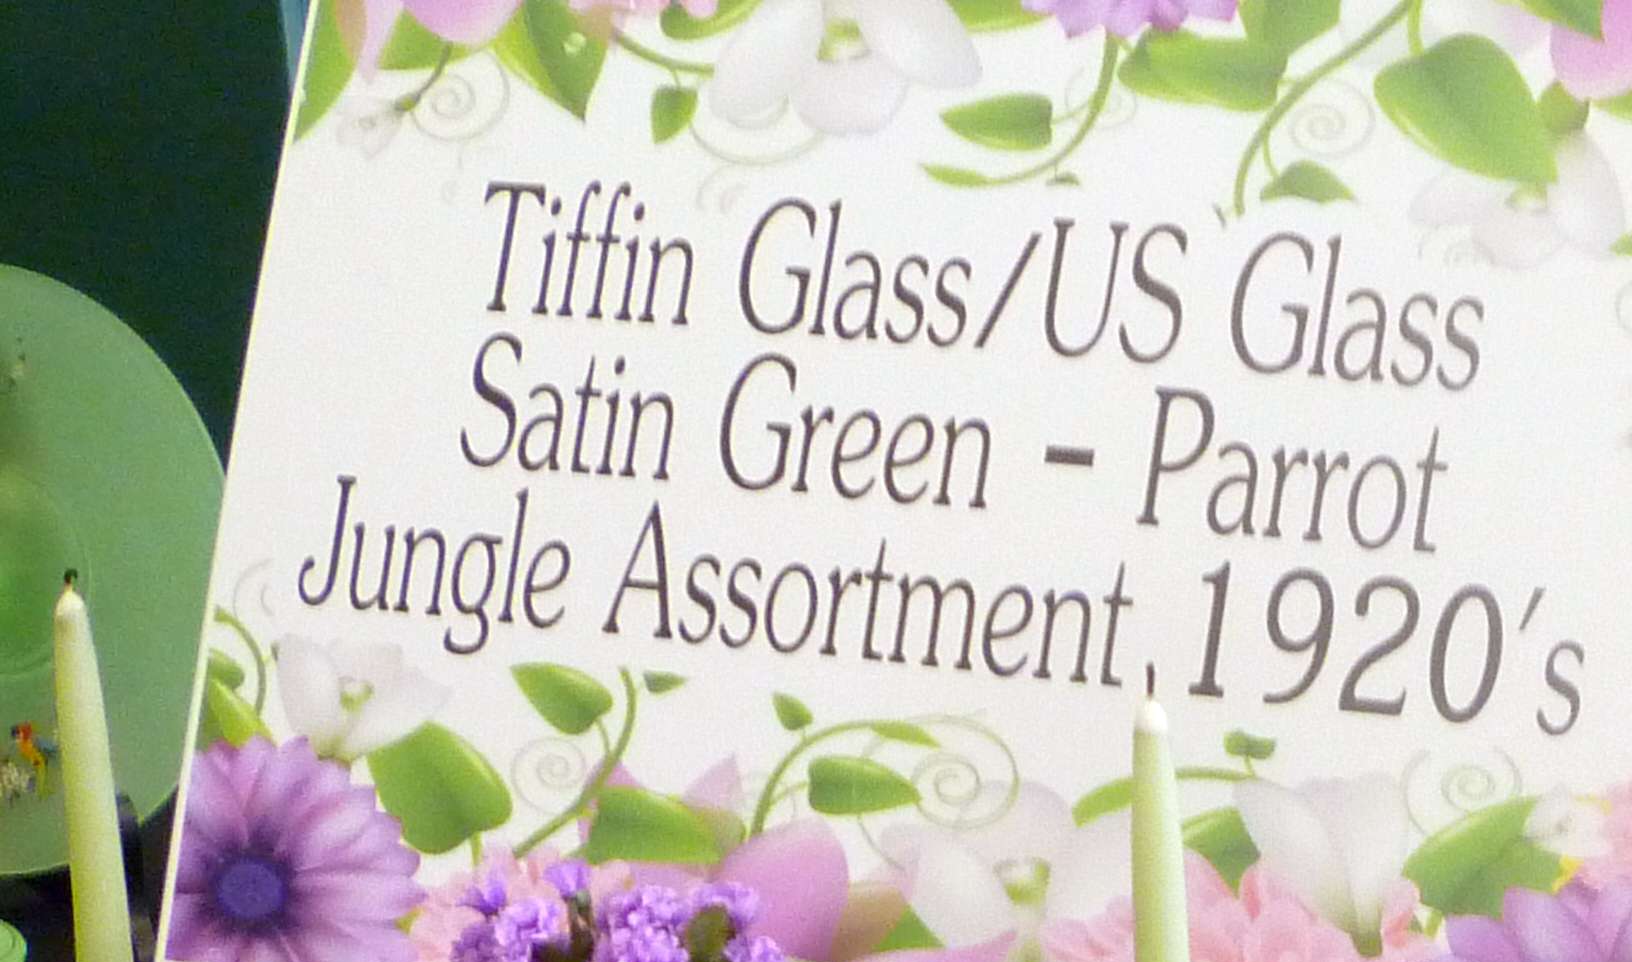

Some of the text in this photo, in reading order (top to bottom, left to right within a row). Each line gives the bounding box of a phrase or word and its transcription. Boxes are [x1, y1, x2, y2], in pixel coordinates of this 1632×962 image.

[484, 181, 1485, 390] Tiffin Glass/US Glass
[460, 333, 674, 481] Satin
[720, 353, 991, 509] Green
[1137, 389, 1448, 553] Parrot
[298, 475, 571, 656] Jungle
[1188, 562, 1584, 736] 1920's
